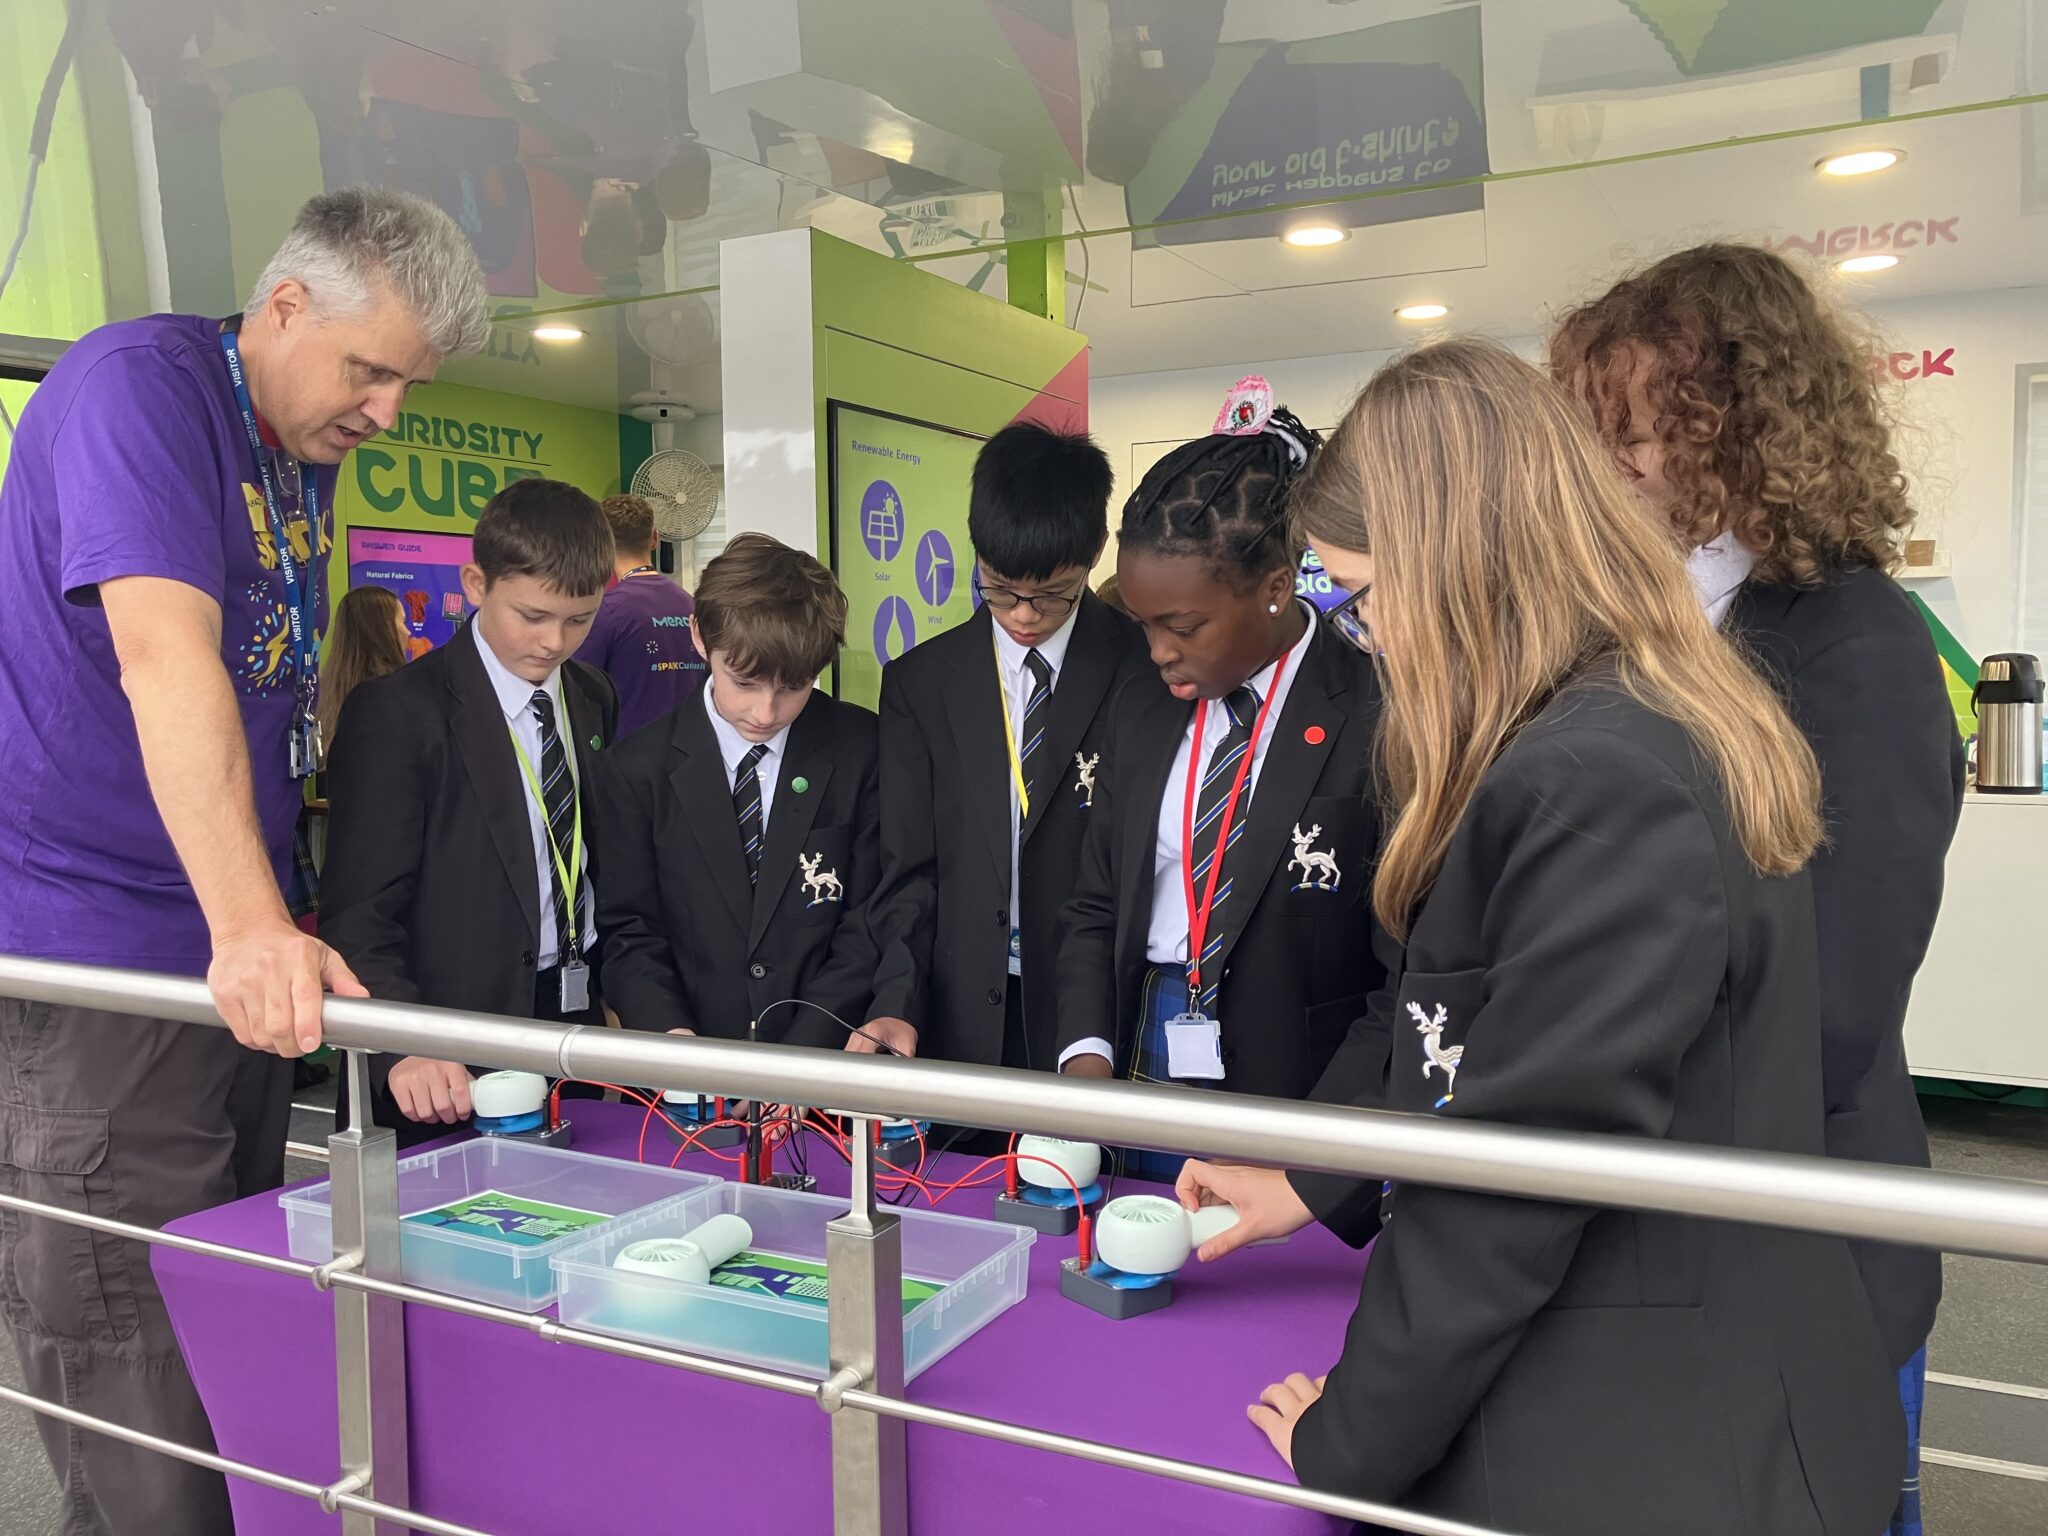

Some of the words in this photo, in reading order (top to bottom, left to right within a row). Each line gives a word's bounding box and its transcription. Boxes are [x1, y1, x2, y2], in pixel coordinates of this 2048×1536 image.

[226, 348, 242, 387] VISITOR
[242, 410, 256, 448] VISITOR
[384, 411, 543, 459] URIOSITY
[851, 440, 894, 459] Renewable
[896, 449, 921, 465] Energy
[356, 447, 546, 521] CUB
[398, 543, 422, 552] GUIDE
[280, 547, 295, 585] VISITOR
[366, 571, 390, 579] Natural
[391, 572, 414, 580] Fabrics
[874, 573, 891, 582] Solar
[290, 606, 302, 642] VISITOR
[652, 616, 690, 628] MERC
[928, 615, 943, 624] Wind
